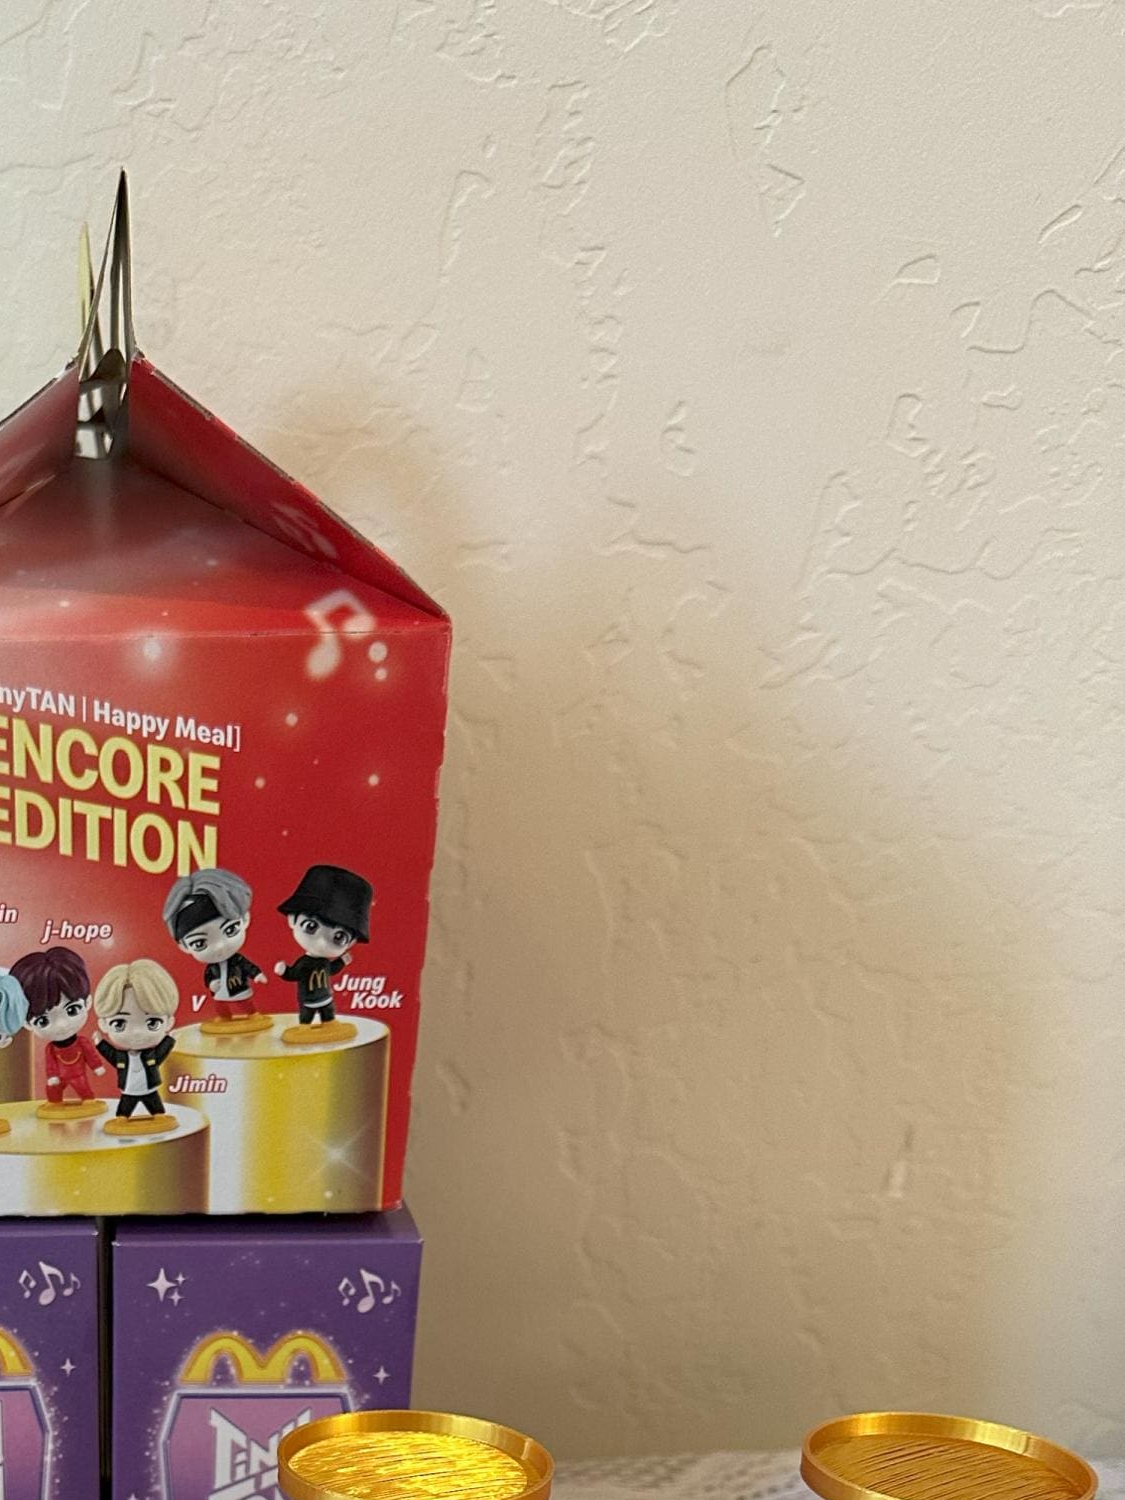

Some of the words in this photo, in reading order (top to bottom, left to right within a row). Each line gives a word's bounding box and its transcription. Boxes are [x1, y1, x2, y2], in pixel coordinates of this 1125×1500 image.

[93, 699, 170, 740] Happy
[41, 920, 112, 944] j-hope
[333, 974, 386, 994] Jung
[191, 995, 207, 1012] V
[350, 991, 404, 1010] Kook
[169, 1074, 227, 1093] Jimin
